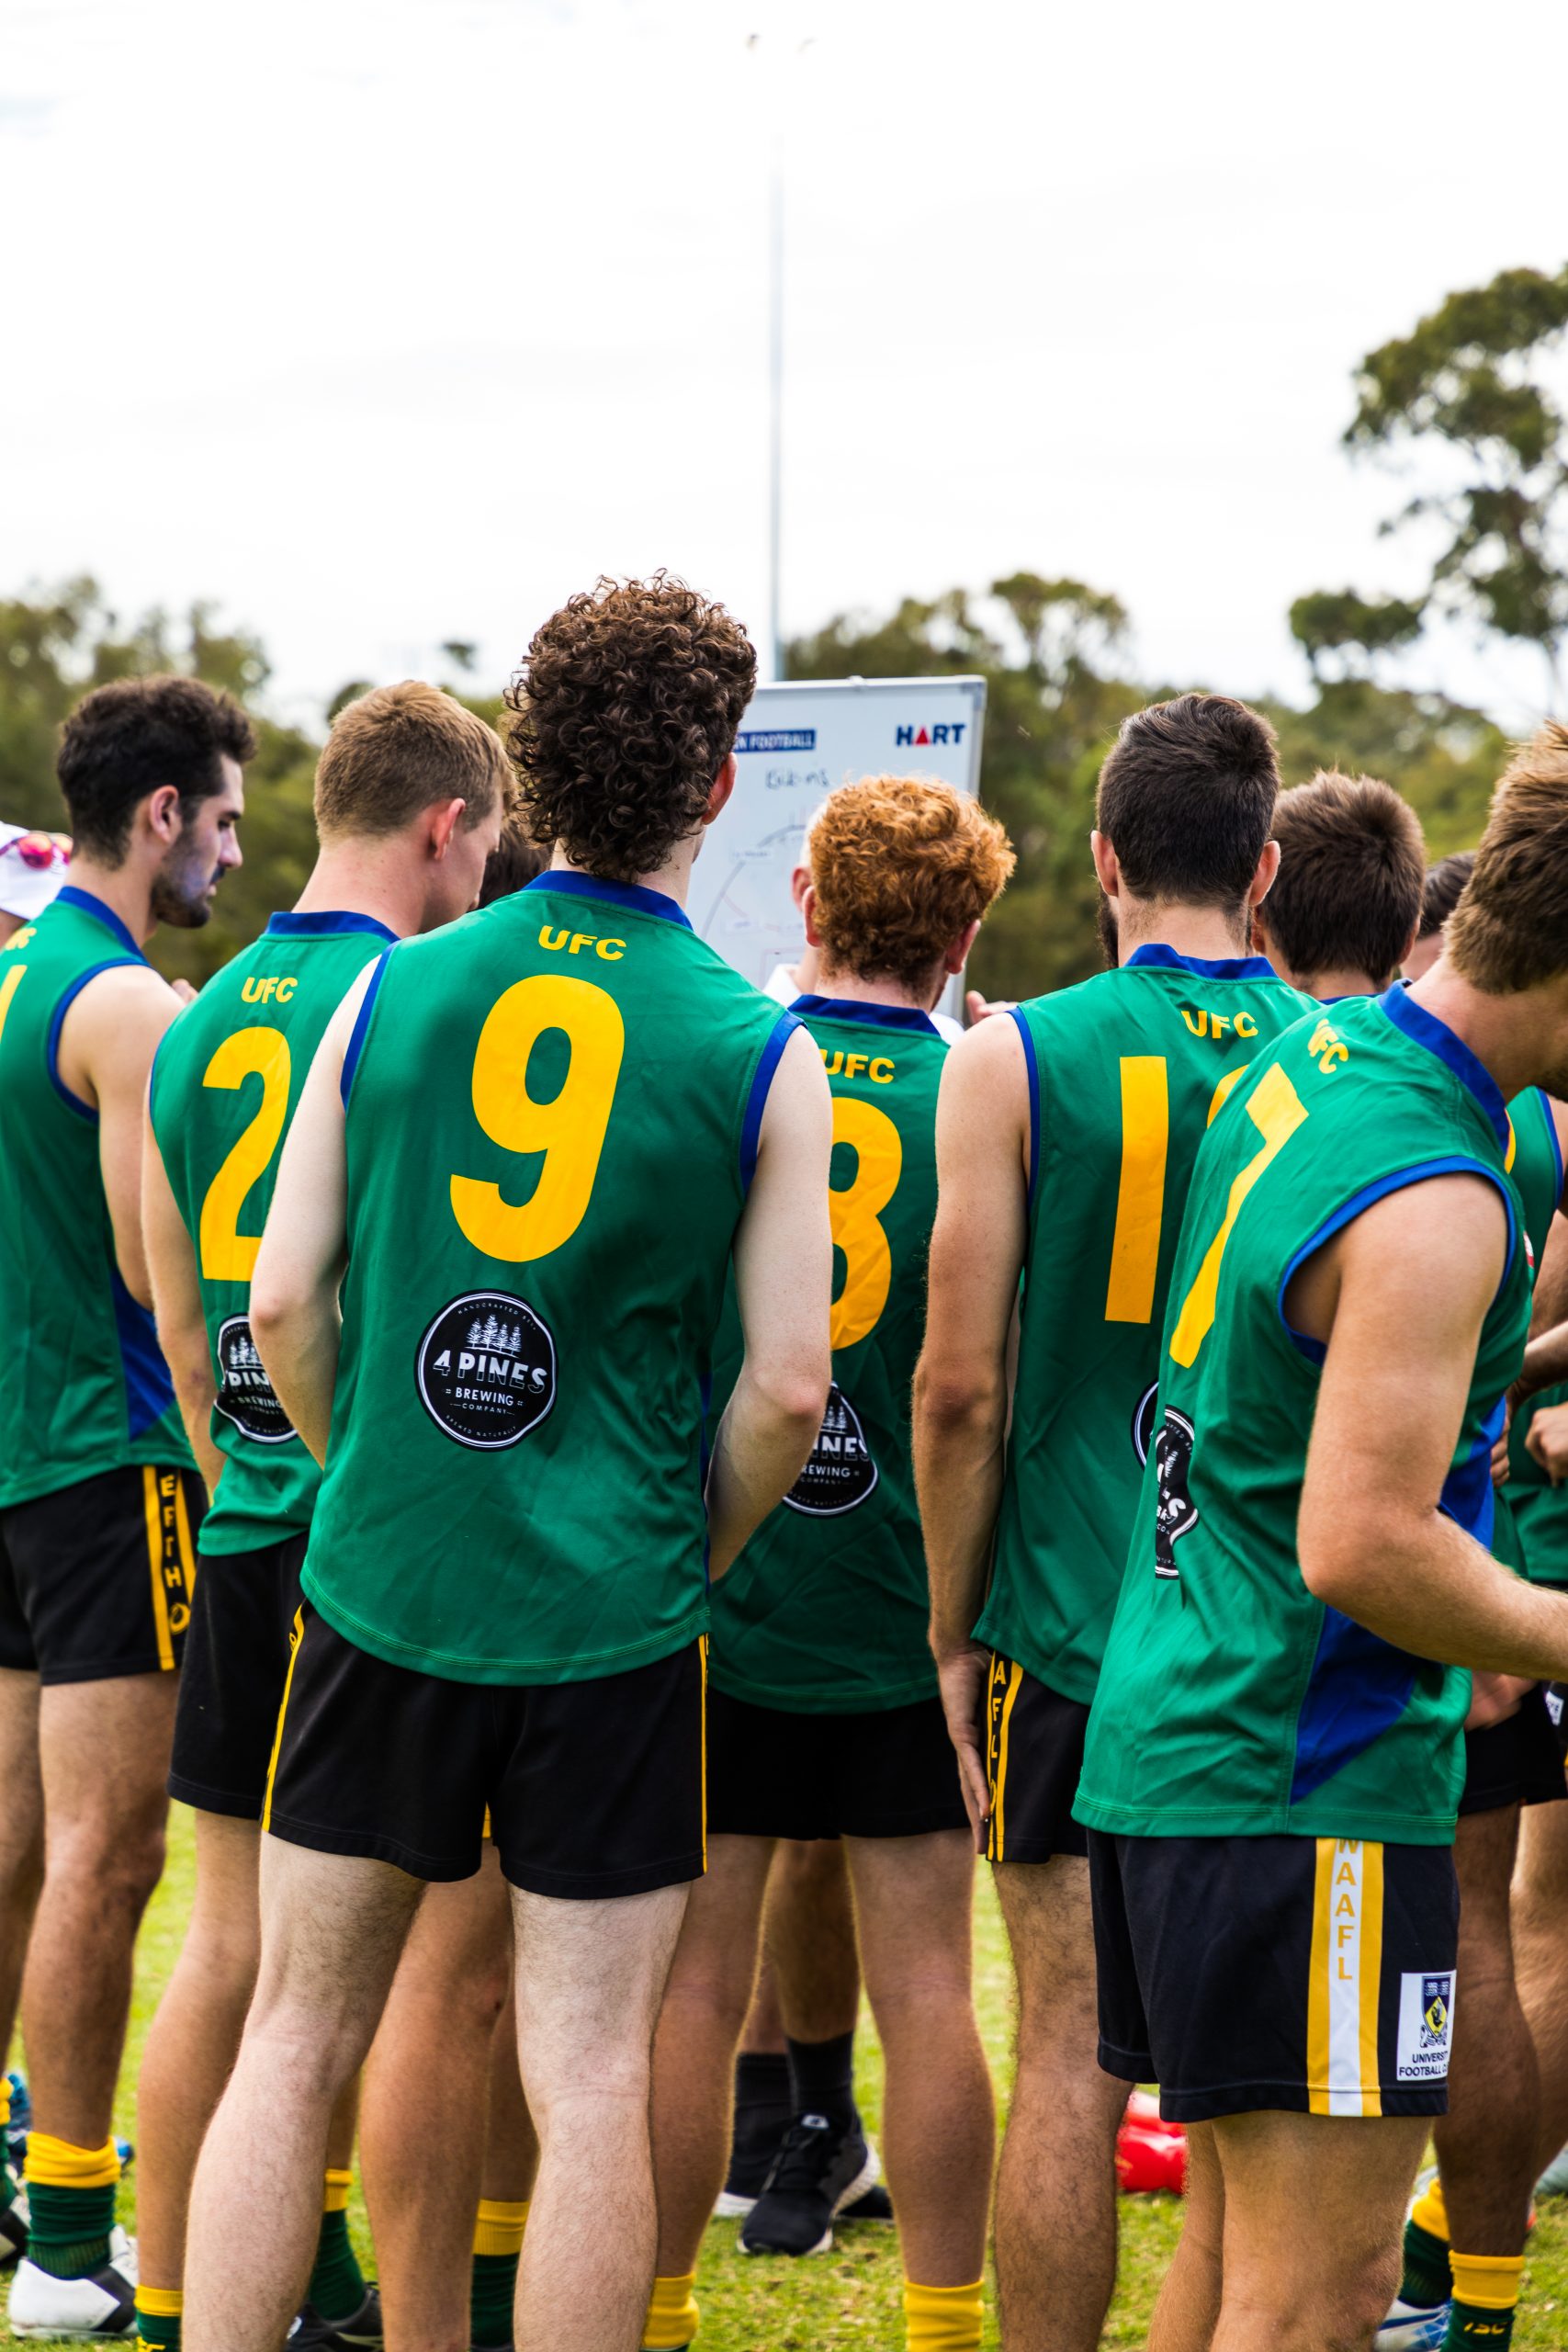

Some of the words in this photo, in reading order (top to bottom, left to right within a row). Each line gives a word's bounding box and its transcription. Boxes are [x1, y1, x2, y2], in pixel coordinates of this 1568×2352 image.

[896, 724, 965, 746] HART
[538, 925, 626, 960] UFC
[242, 978, 298, 1003] UFC
[1181, 1011, 1258, 1039] UFC
[820, 1049, 895, 1083] UFC
[450, 974, 625, 1262] 9
[199, 1026, 291, 1282] 2
[228, 1371, 272, 1393] PIN
[433, 1350, 451, 1376] 4
[457, 1351, 547, 1394] PINES
[455, 1386, 514, 1407] BREWING
[462, 1402, 507, 1415] COMPANY
[160, 1474, 182, 1589] ERTH
[990, 1660, 1007, 1758] AFL
